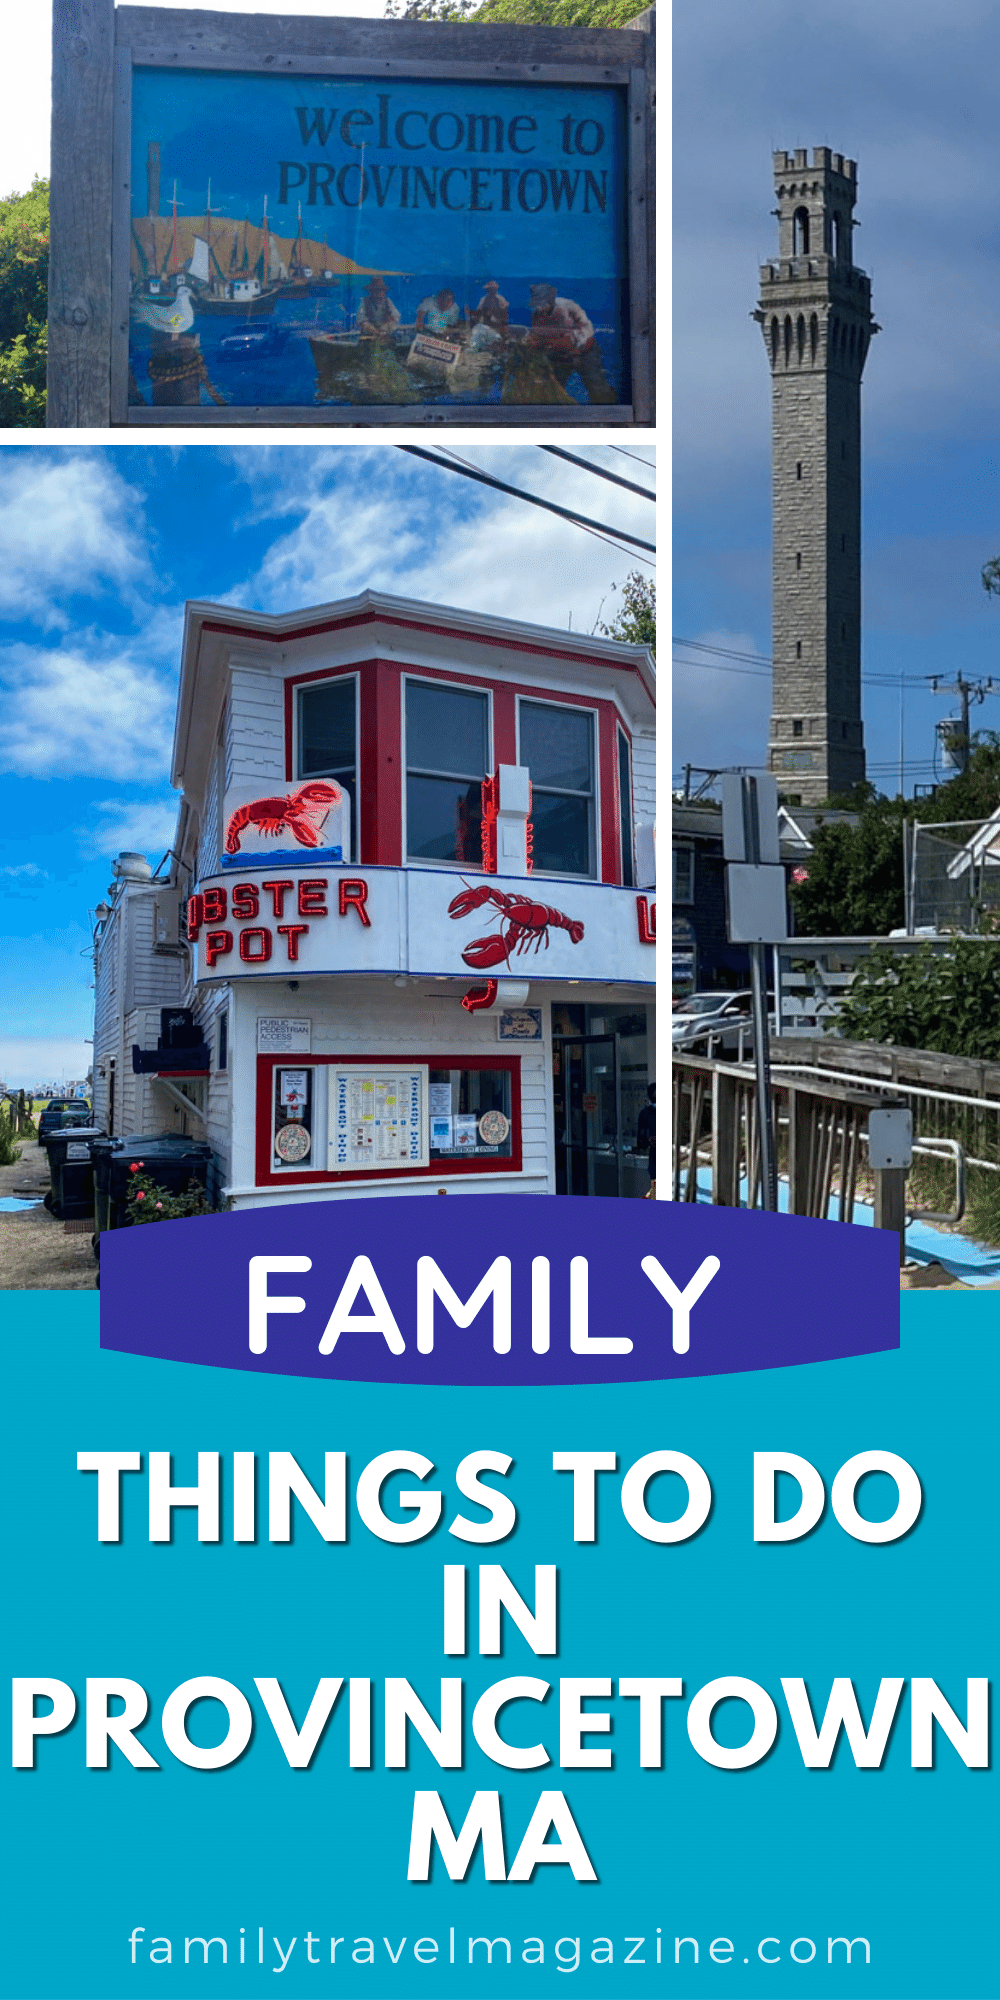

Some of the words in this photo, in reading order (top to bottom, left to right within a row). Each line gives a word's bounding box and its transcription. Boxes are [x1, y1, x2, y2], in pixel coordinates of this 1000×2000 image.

[294, 93, 539, 155] welcome
[560, 110, 606, 156] to
[277, 160, 609, 214] PROVINCETOWN
[187, 878, 372, 942] OBSTER
[206, 924, 310, 967] POT
[338, 1077, 348, 1129] WATERFRONT
[410, 1076, 420, 1127] WATERFRONT
[338, 1133, 347, 1163] DINING
[409, 1131, 419, 1160] DINING
